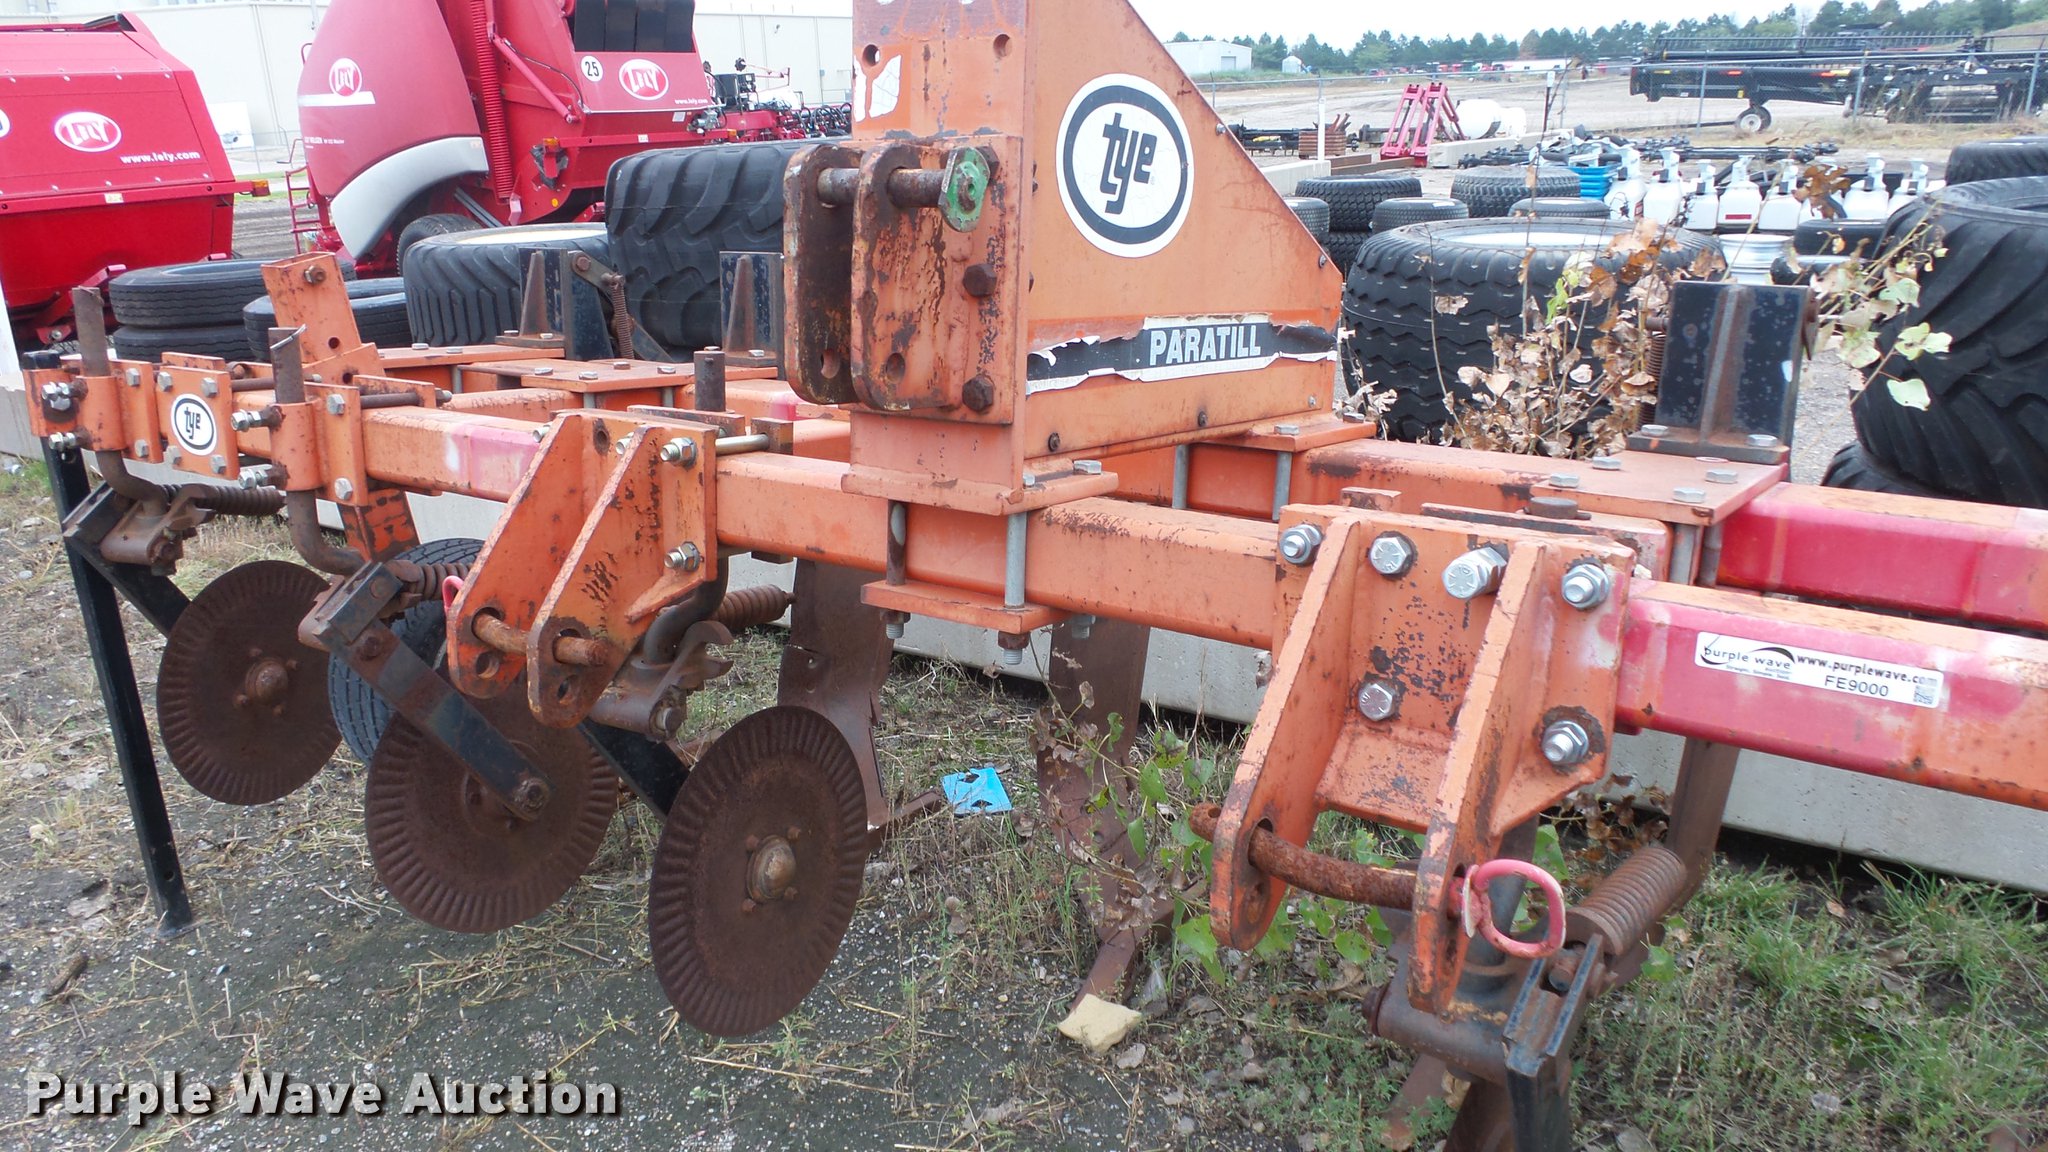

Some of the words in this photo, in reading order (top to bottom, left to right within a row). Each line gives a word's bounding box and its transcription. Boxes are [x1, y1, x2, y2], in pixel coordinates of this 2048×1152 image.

[584, 60, 600, 77] 25
[120, 151, 201, 165] www.lely.com
[1099, 112, 1157, 215] tye
[1149, 325, 1261, 366] PARATILL
[184, 407, 201, 440] tye
[1704, 646, 1749, 662] purple
[1754, 656, 1792, 670] wave
[1824, 674, 1889, 697] FE9000
